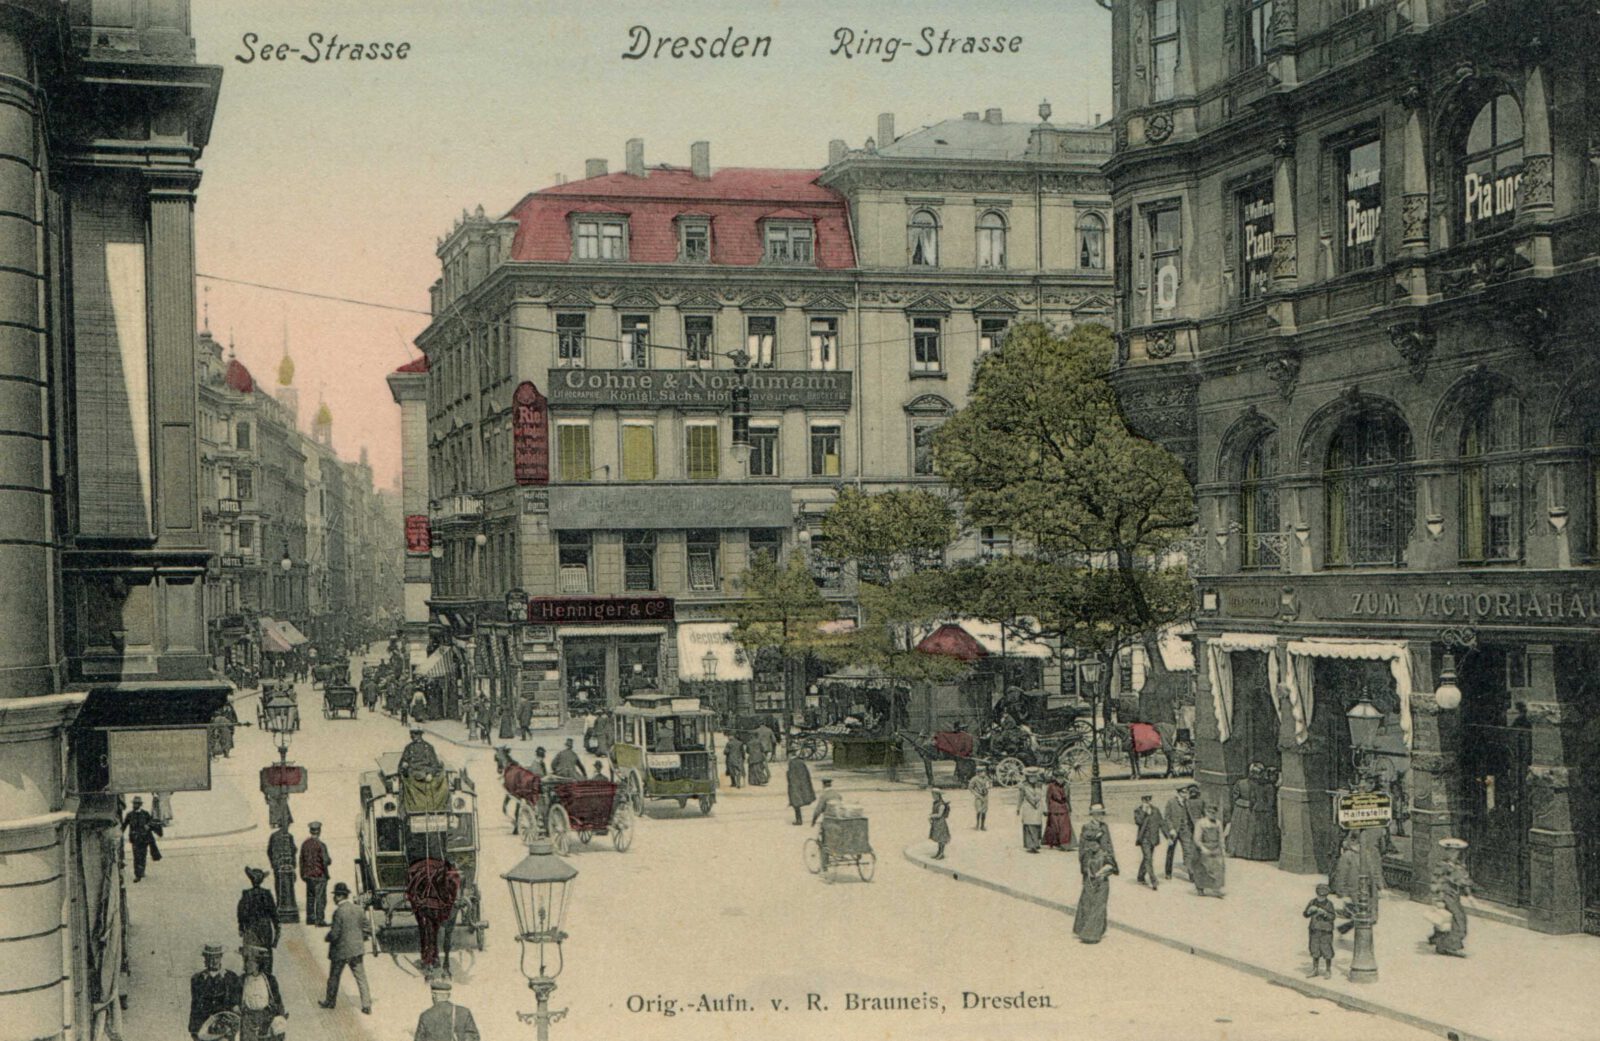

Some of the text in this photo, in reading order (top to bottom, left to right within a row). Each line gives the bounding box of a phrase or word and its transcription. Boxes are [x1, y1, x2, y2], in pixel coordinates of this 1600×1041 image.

[663, 371, 679, 389] &
[541, 602, 626, 620] Henniger
[630, 603, 641, 616] &
[1351, 592, 1401, 615] ZUM
